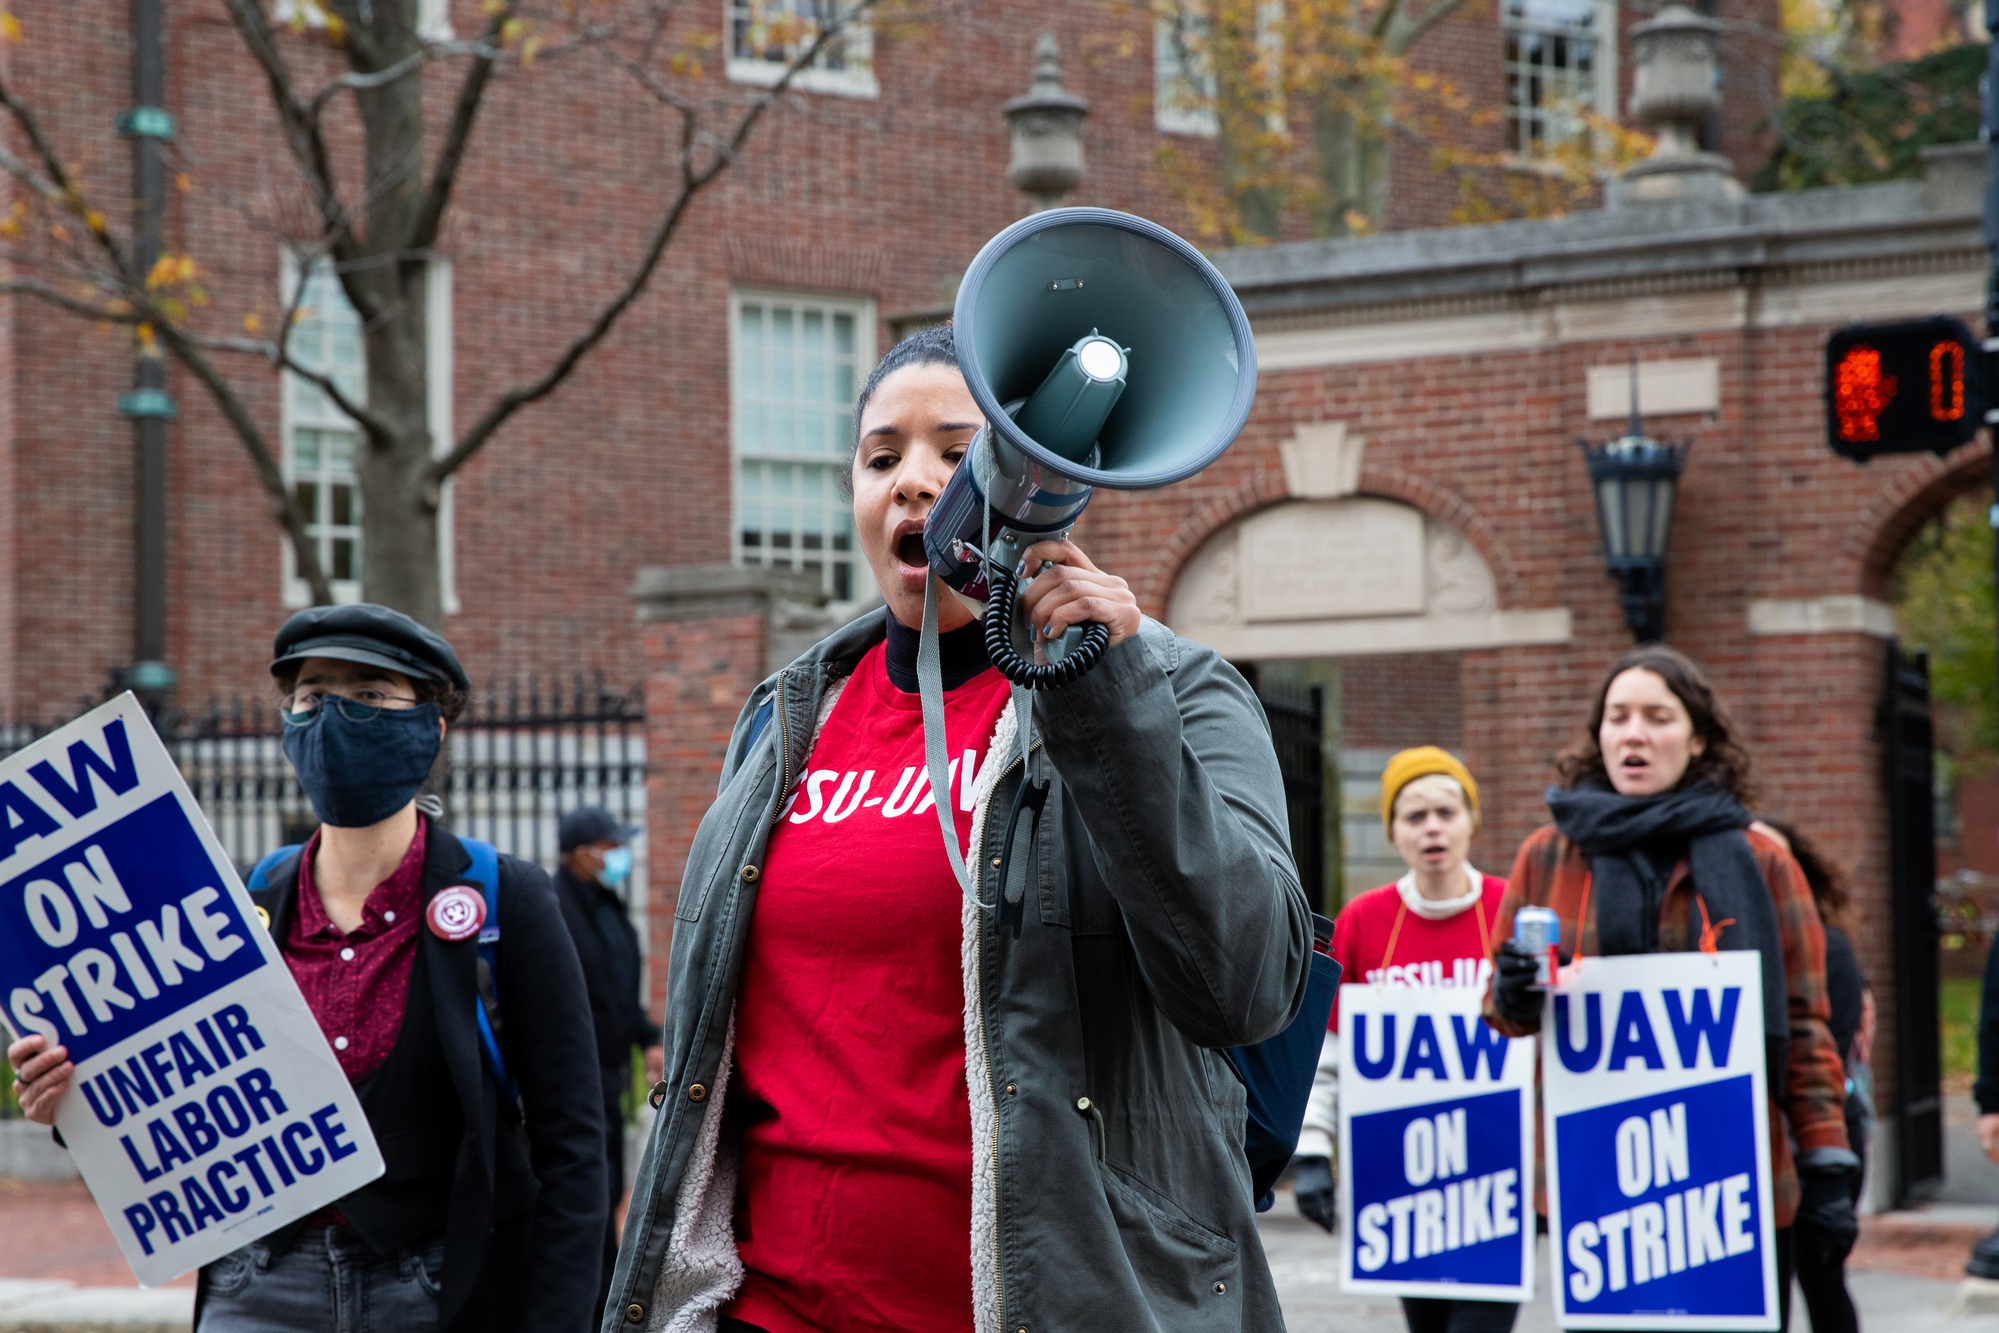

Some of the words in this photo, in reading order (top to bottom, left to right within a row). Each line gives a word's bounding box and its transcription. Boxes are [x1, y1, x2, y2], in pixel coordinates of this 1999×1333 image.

[24, 844, 131, 948] ON
[10, 886, 245, 1048] STRIKE
[80, 1003, 266, 1128] UNFAIR
[1353, 1013, 1510, 1080] UAW
[1553, 986, 1742, 1073] UAW
[120, 1066, 288, 1183] LABOR
[1403, 1107, 1467, 1187] ON
[1615, 1102, 1689, 1198] ON
[123, 1103, 357, 1256] PRACTICE
[1357, 1168, 1519, 1272] STRIKE
[1568, 1173, 1754, 1303] STRIKE
